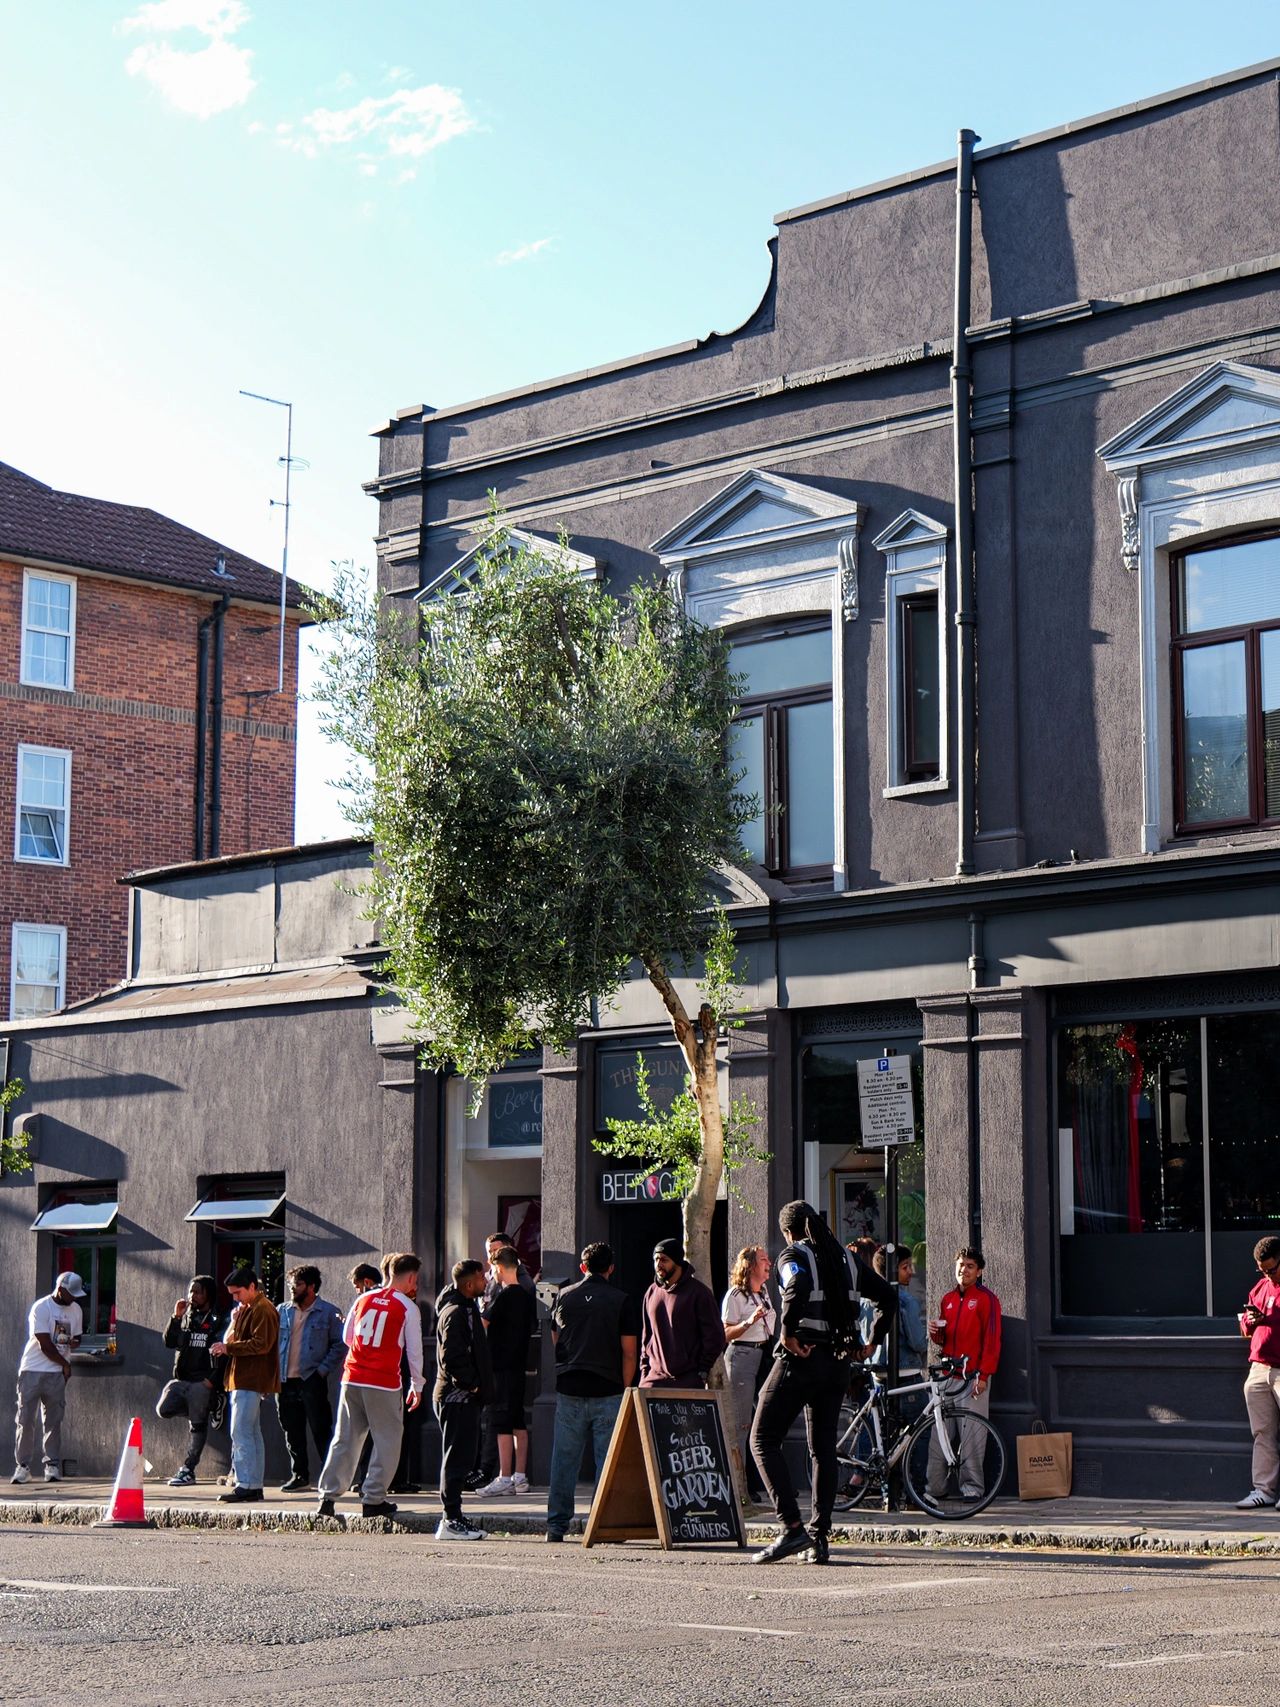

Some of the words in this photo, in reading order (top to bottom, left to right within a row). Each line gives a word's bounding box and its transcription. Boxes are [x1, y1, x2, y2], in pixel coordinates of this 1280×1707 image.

[355, 1308, 389, 1348] 41
[675, 1402, 688, 1415] YOU
[690, 1403, 707, 1416] SEEN
[671, 1414, 688, 1426] OUR
[670, 1429, 707, 1451] Secret
[668, 1445, 716, 1473] BEER
[661, 1471, 731, 1510] GARDEN
[682, 1516, 701, 1524] THE
[680, 1522, 730, 1539] GUNNERS
